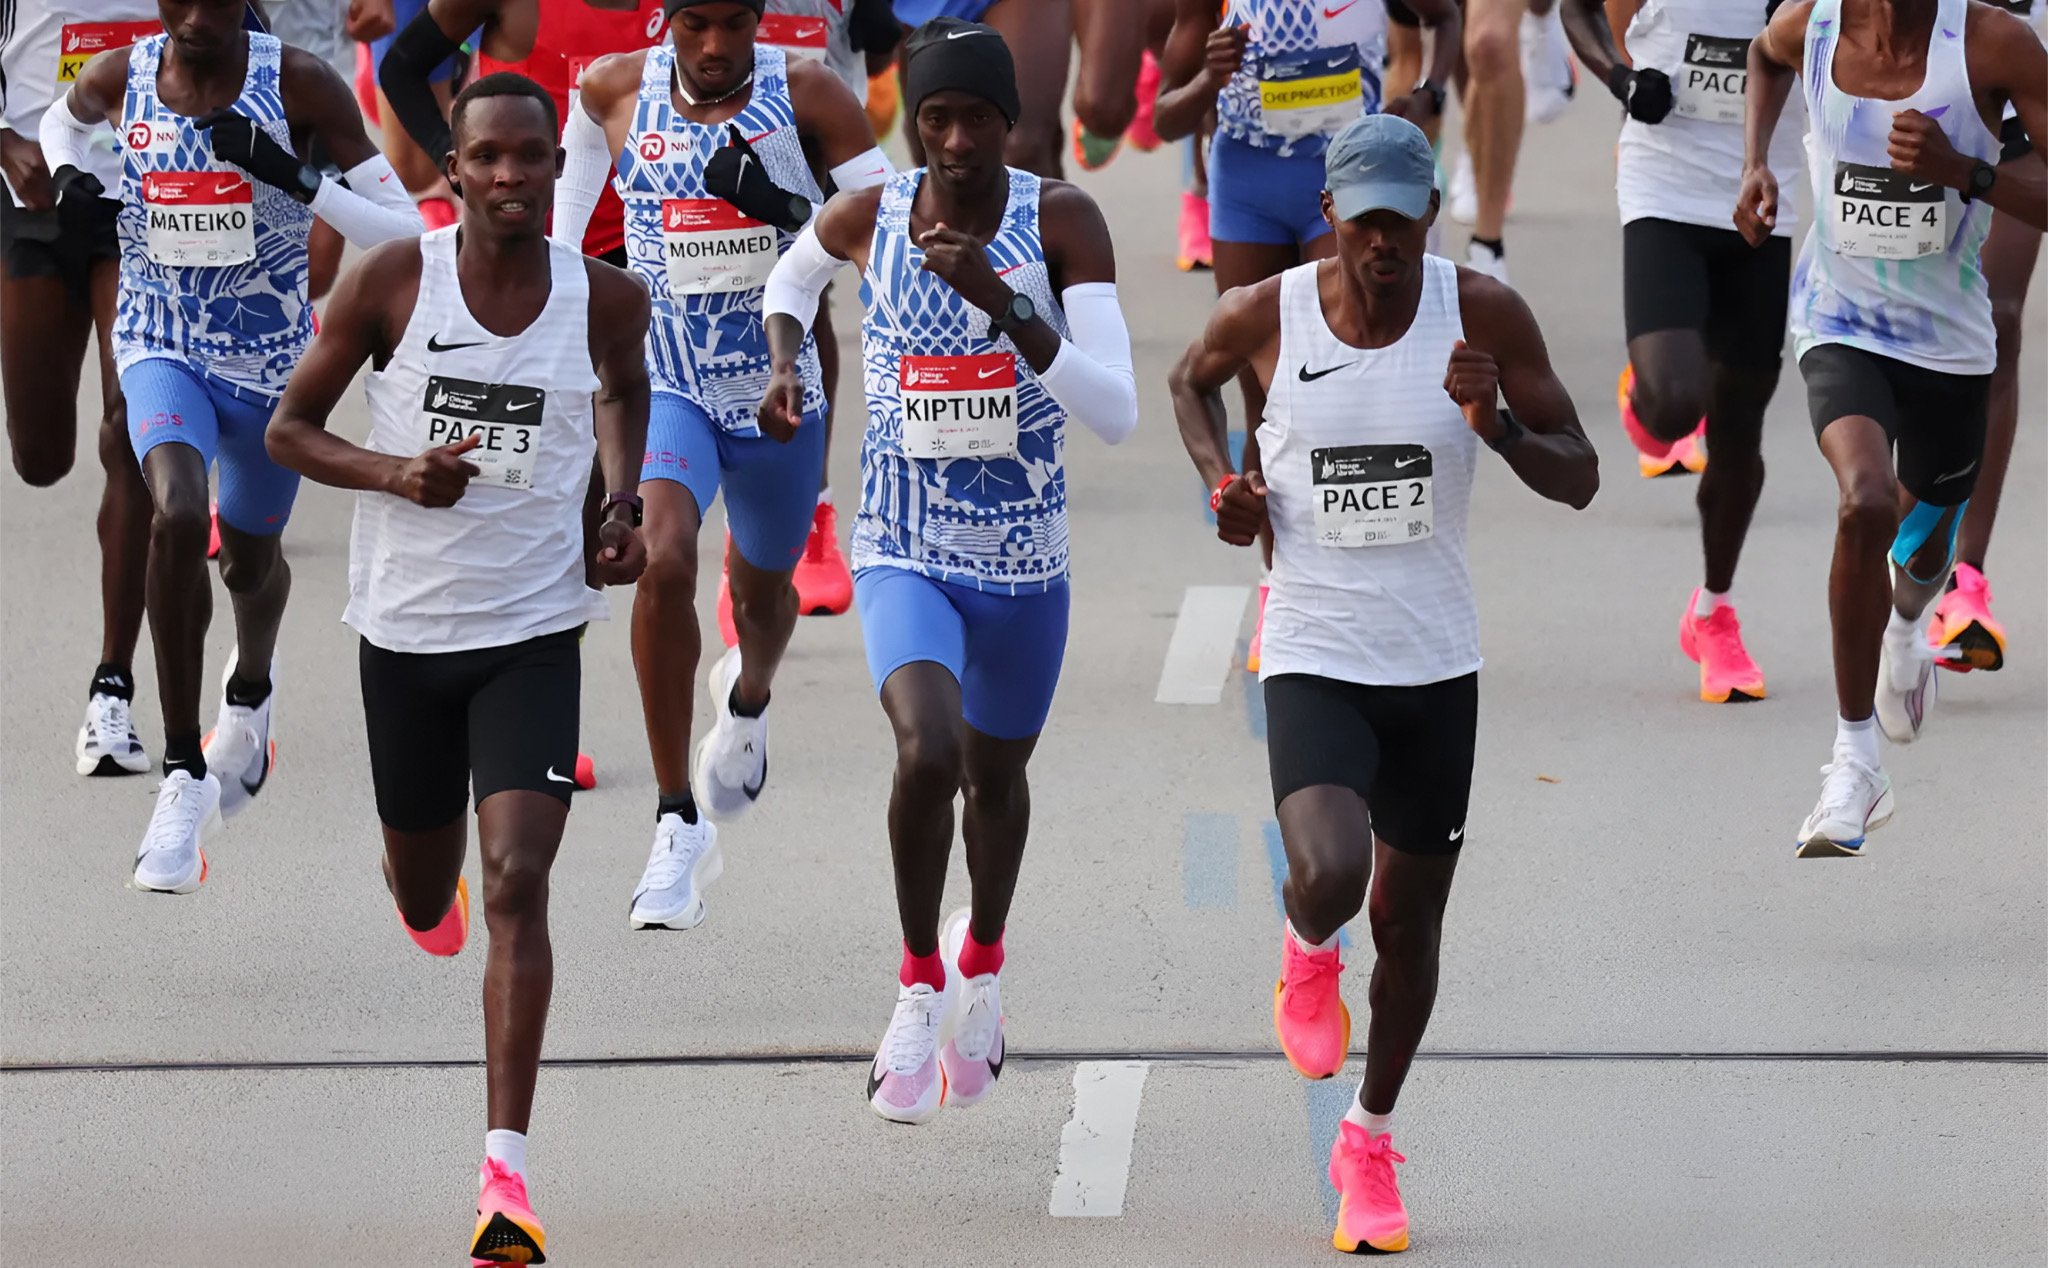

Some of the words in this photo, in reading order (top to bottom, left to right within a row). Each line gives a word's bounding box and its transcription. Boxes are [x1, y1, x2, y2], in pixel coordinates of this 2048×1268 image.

[156, 132, 174, 141] NN
[671, 142, 689, 151] NN
[151, 211, 246, 231] MATEIKO
[1842, 201, 1911, 227] PACE
[1921, 206, 1938, 227] 4
[670, 236, 771, 258] MOHAMED
[906, 395, 1011, 421] KIPTUM
[513, 429, 530, 453] 3
[1323, 485, 1399, 512] PACE
[1409, 482, 1425, 506] 2
